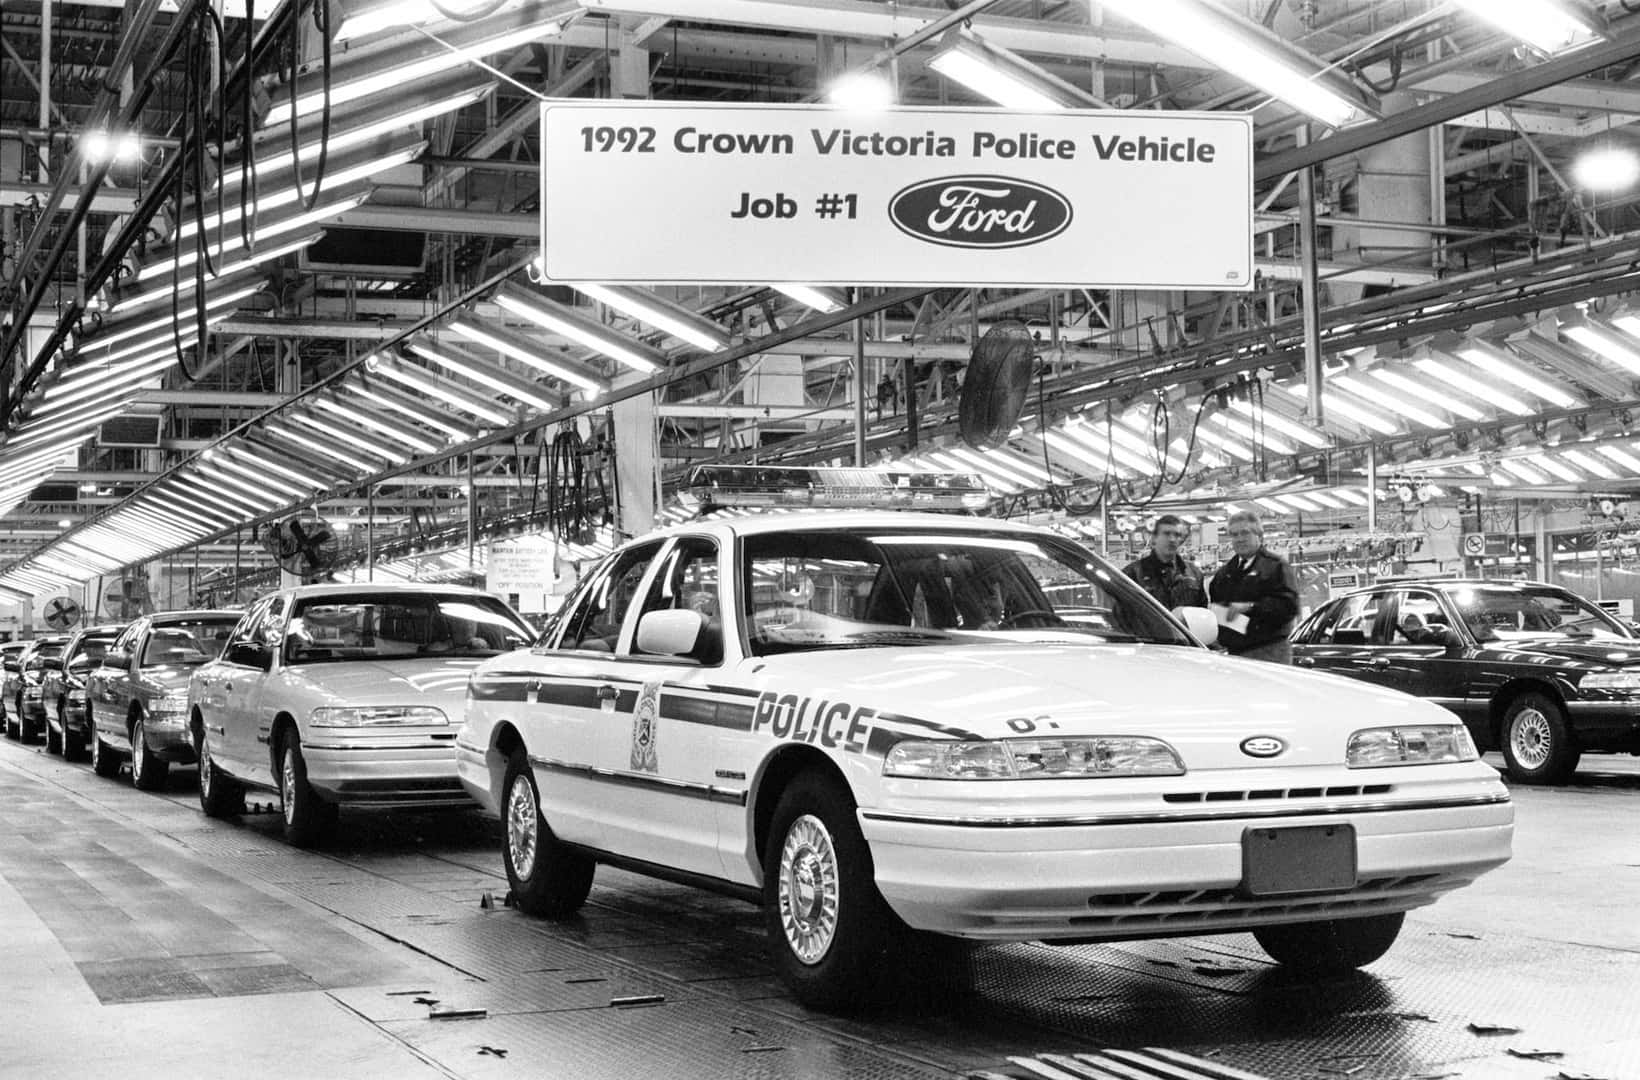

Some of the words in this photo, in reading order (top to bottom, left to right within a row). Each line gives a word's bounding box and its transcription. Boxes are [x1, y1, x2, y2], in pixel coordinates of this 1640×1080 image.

[581, 126, 657, 154] 1992
[673, 128, 794, 154] Crown
[811, 129, 956, 157] Victoria
[972, 131, 1076, 160] Police
[1092, 134, 1215, 163] Vehicle
[730, 192, 798, 219] Job
[814, 193, 858, 219] #1
[927, 185, 1037, 233] Ford
[753, 690, 878, 754] POLICE
